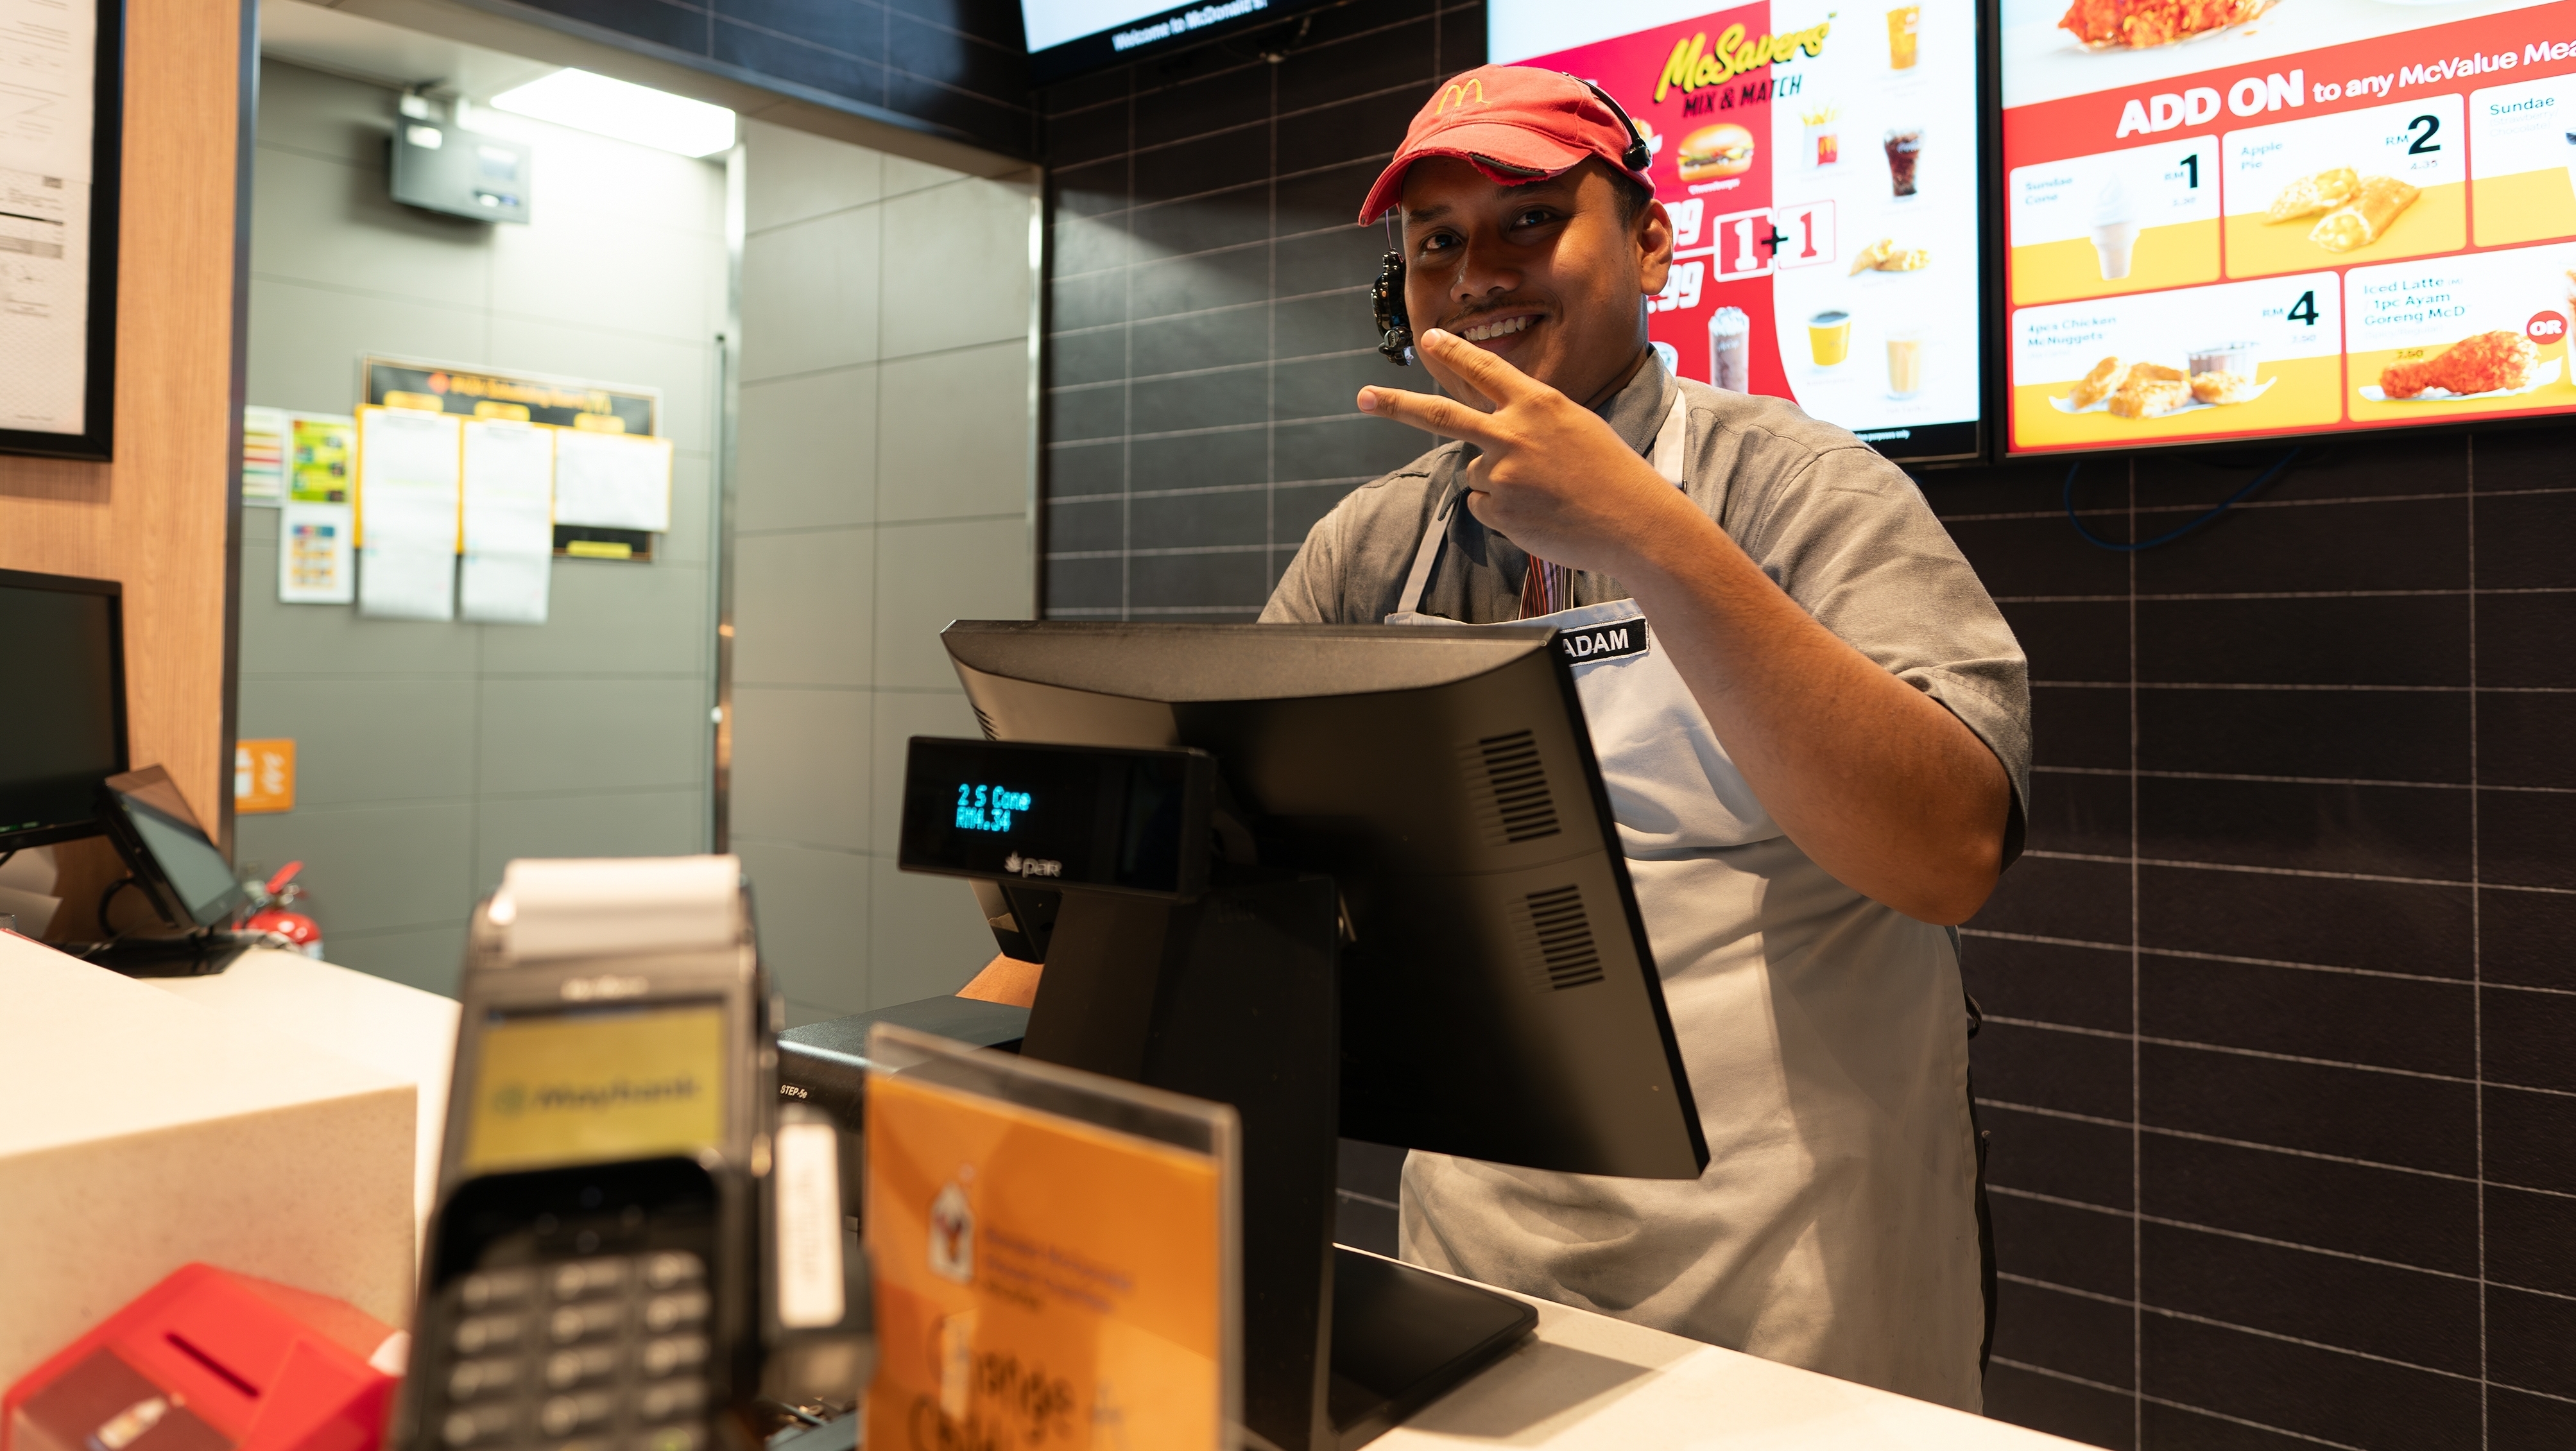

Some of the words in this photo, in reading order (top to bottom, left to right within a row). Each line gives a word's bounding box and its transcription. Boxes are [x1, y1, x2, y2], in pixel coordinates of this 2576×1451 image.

[1112, 21, 1171, 52] Welcome
[1169, 17, 1186, 35] to
[1653, 22, 1830, 103] McSavers
[1682, 89, 1714, 118] MIX
[1720, 87, 1734, 109] &
[1740, 74, 1803, 107] MATCH
[2115, 87, 2221, 139] ADD
[2228, 69, 2305, 118] ON
[2312, 82, 2340, 103] to
[2345, 72, 2395, 101] any
[2398, 51, 2518, 88] McValue
[2490, 97, 2555, 116] Sundae
[2385, 134, 2409, 146] RM
[2407, 114, 2441, 155] 2
[2240, 142, 2283, 160] Apple
[2179, 151, 2199, 189] 1
[2364, 281, 2398, 295] Iced
[2402, 277, 2444, 291] Latte
[2286, 289, 2320, 327] 4
[2373, 298, 2400, 312] 1pc
[2404, 293, 2451, 309] Ayam
[2061, 316, 2117, 329] Chicken
[2364, 311, 2424, 328] Goreng
[2427, 305, 2466, 319] McD
[2529, 320, 2563, 337] OR
[1895, 429, 1911, 440] only
[1563, 628, 1629, 658] ADAM
[957, 783, 970, 807] 2
[975, 784, 988, 807] S
[992, 786, 1032, 812] Cone
[956, 806, 1012, 832] RM4.34
